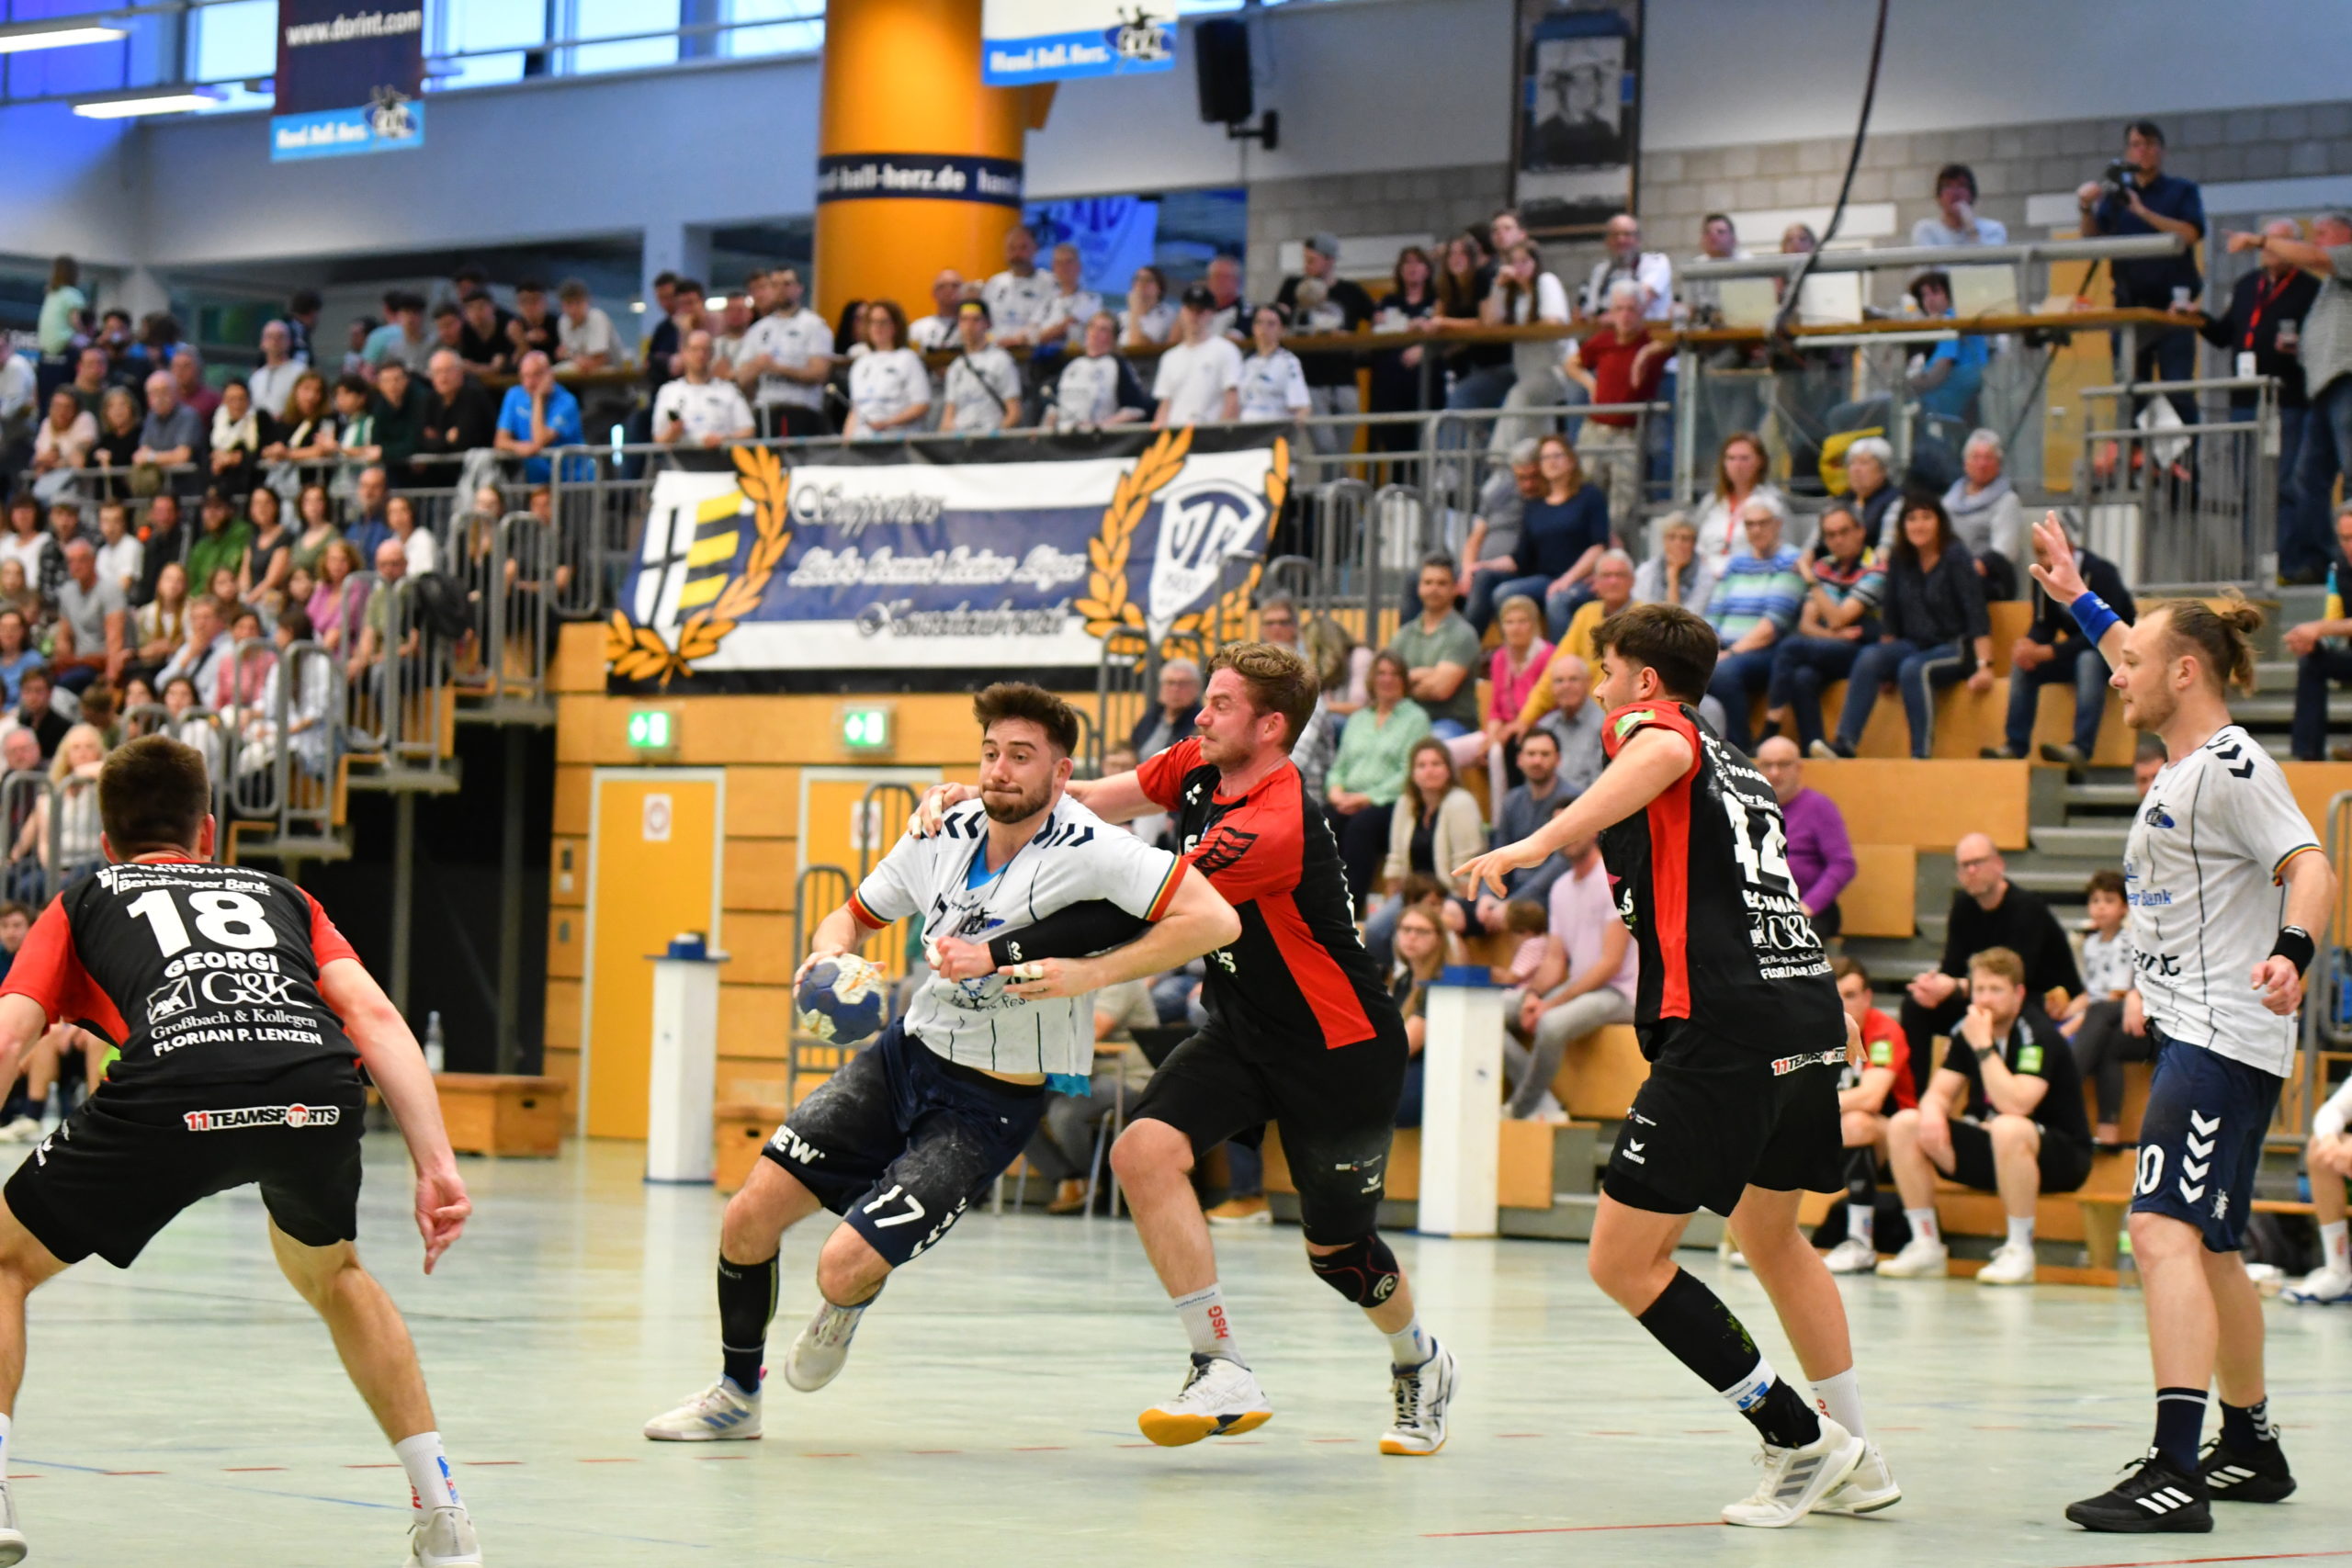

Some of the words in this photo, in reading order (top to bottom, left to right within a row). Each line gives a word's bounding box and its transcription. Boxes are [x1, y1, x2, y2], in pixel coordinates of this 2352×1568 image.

[286, 10, 422, 46] www.dorint.com
[119, 877, 223, 892] Bensberger
[224, 878, 271, 893] Bank
[2141, 888, 2173, 907] Bank
[126, 888, 278, 959] 18
[164, 951, 280, 978] GEORGI
[200, 971, 313, 1010] G&K
[150, 1010, 231, 1040] Großbach
[233, 1010, 250, 1023] &
[251, 1008, 319, 1029] Kollegen
[153, 1028, 234, 1057] FLORIAN
[236, 1028, 254, 1042] P.
[255, 1027, 323, 1046] LENZEN
[862, 1184, 926, 1229] 17
[1207, 1304, 1229, 1340] HSG
